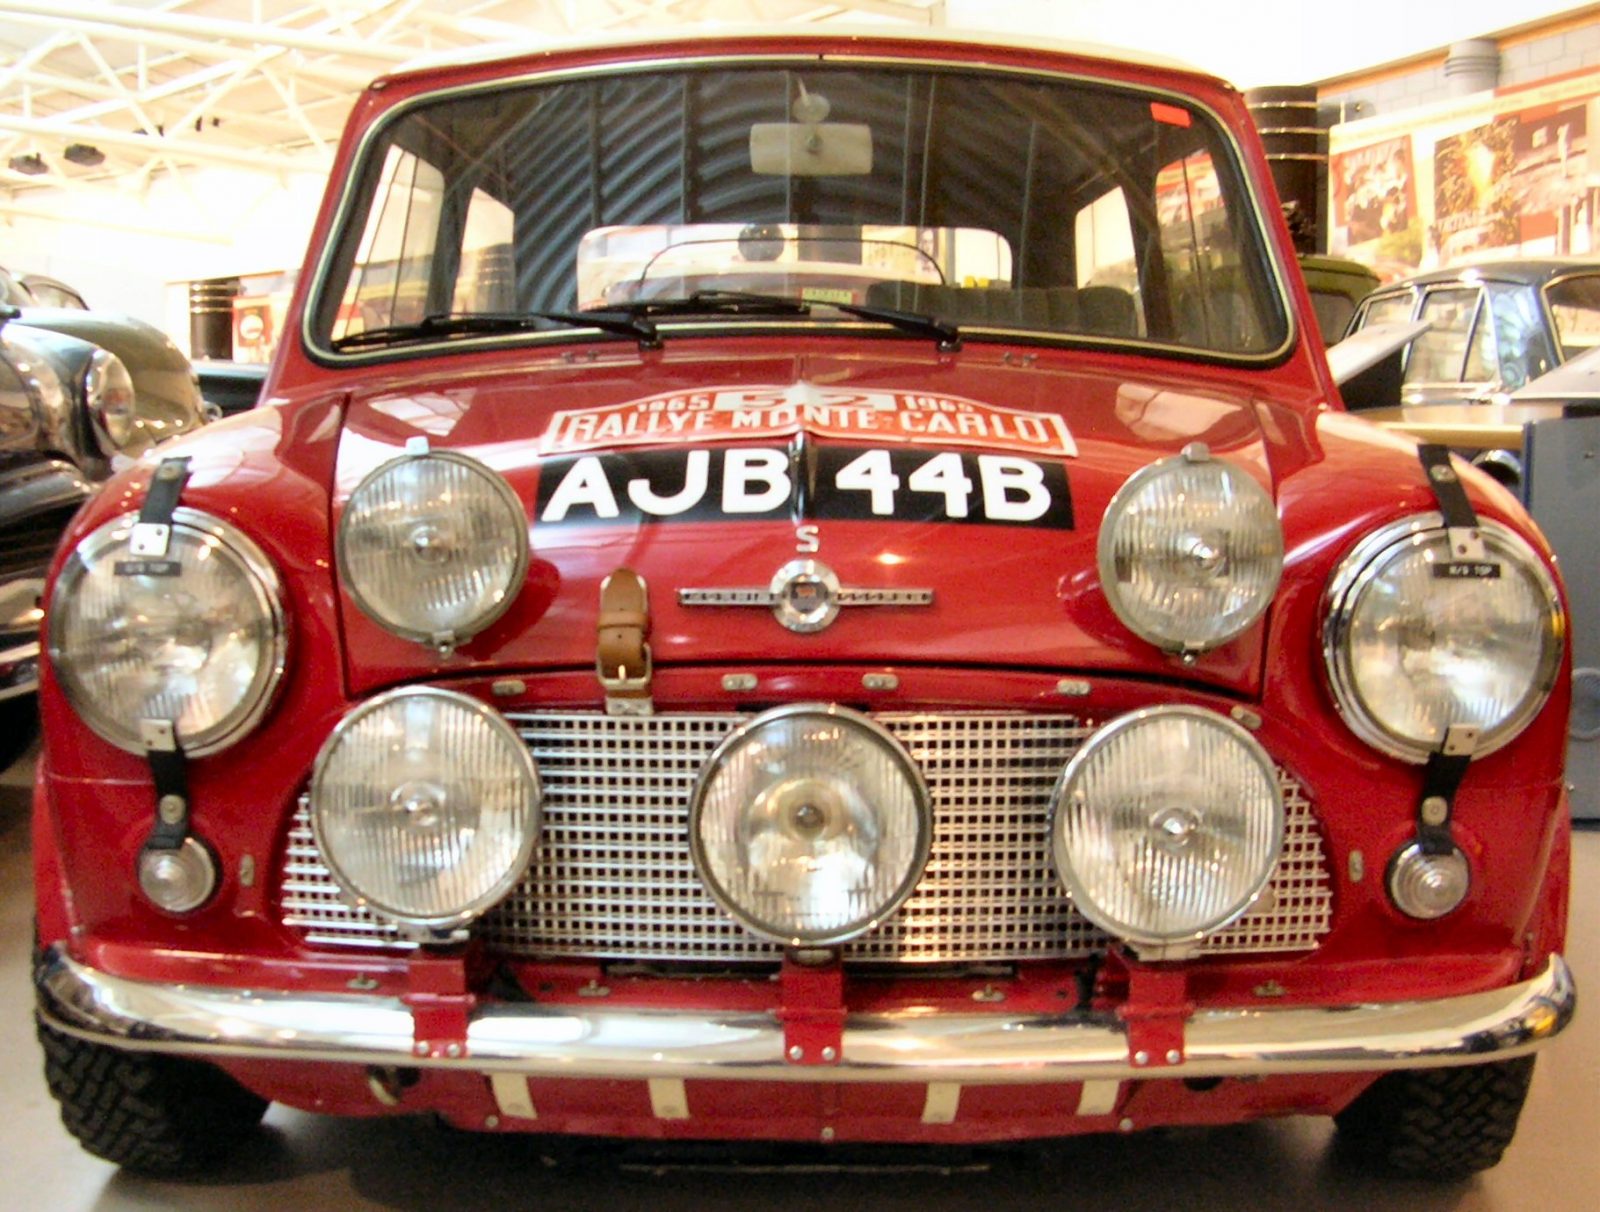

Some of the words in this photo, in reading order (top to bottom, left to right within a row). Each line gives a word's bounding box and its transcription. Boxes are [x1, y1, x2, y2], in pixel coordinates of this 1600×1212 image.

[563, 410, 716, 446] RALLYE
[541, 448, 791, 521] AJB
[835, 449, 1051, 521] 44B
[796, 525, 820, 552] S
